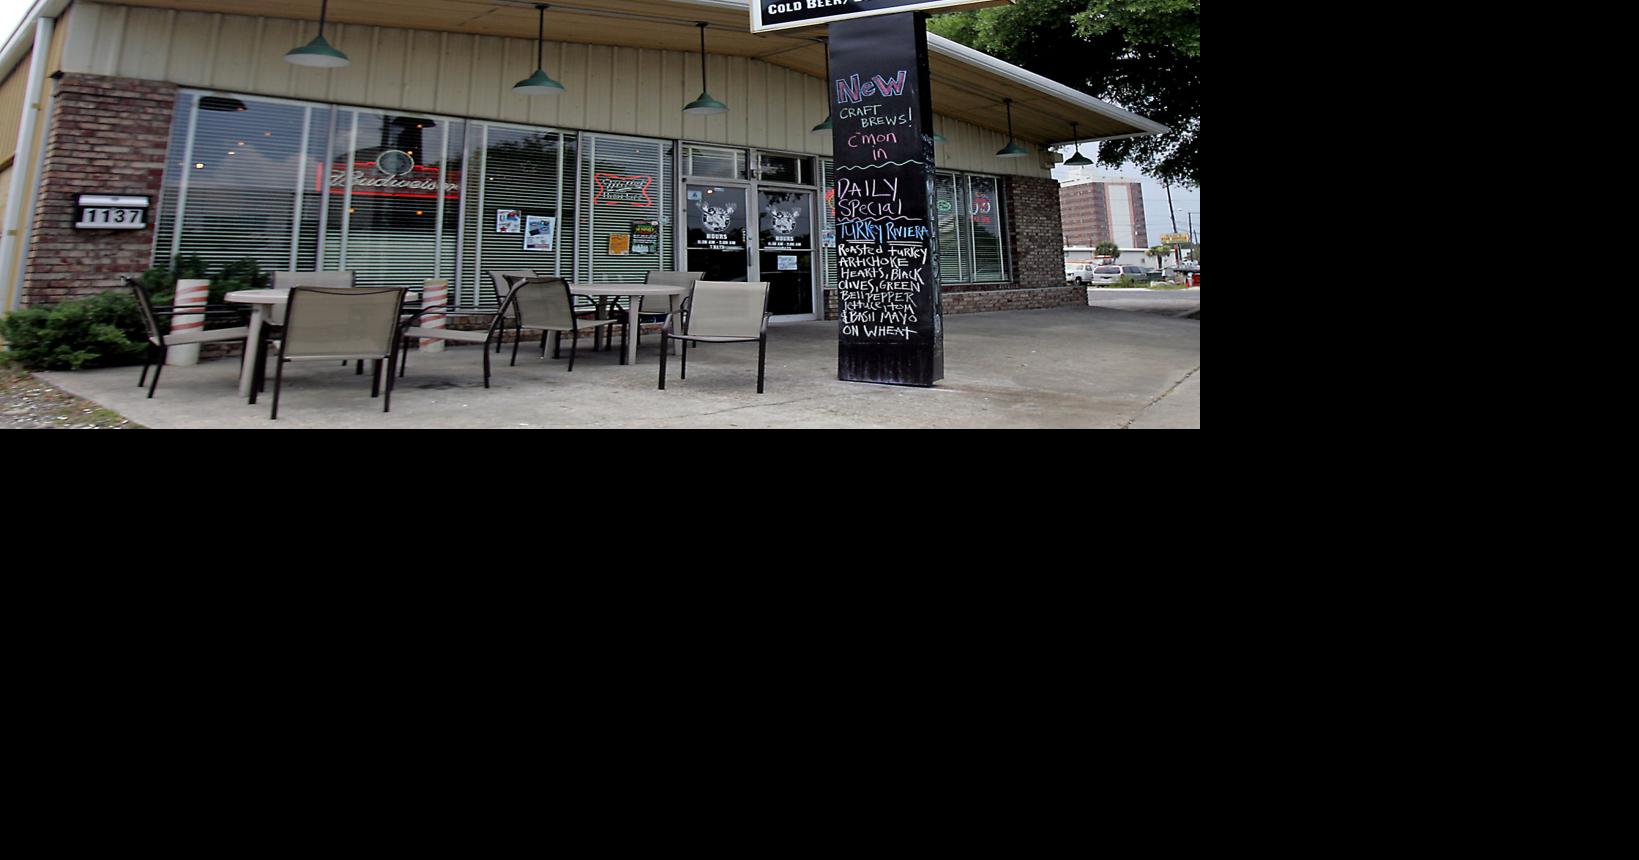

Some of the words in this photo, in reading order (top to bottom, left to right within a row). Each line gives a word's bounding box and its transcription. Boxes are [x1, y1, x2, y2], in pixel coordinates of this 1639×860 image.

[768, 1, 802, 15] COLD
[840, 105, 882, 119] CRAFT
[861, 107, 912, 128] BREWS!
[872, 145, 888, 160] in
[837, 177, 898, 202] DAILY
[88, 209, 140, 223] 1137
[879, 280, 920, 292] GREEN
[865, 292, 917, 307] PEPPER
[880, 311, 918, 325] MAYO
[842, 325, 859, 337] ON
